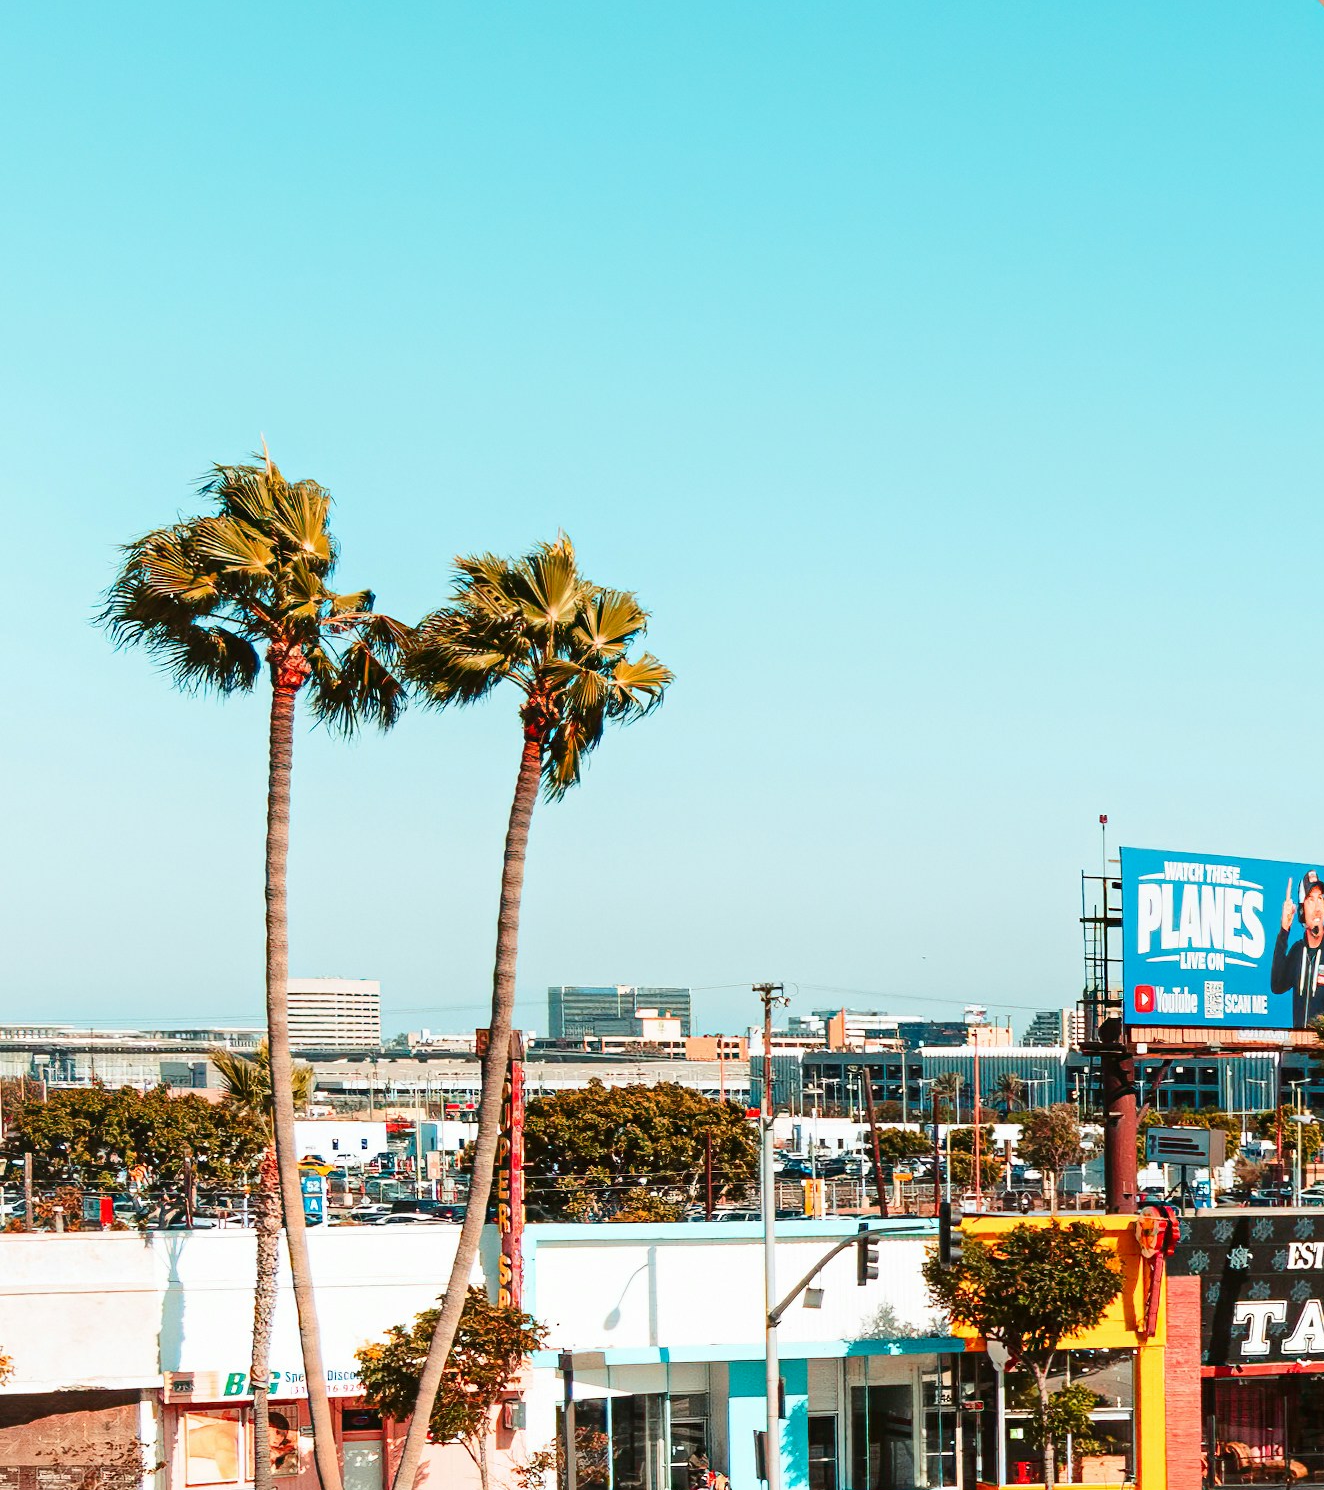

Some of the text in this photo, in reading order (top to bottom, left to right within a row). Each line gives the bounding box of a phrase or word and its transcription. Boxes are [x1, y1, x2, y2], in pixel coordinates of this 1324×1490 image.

[1164, 861, 1241, 885] WATCH THESE
[1138, 883, 1266, 959] PLANES
[1180, 952, 1225, 971] LIVE ON
[1155, 985, 1268, 1014] YouTube SCAN ME
